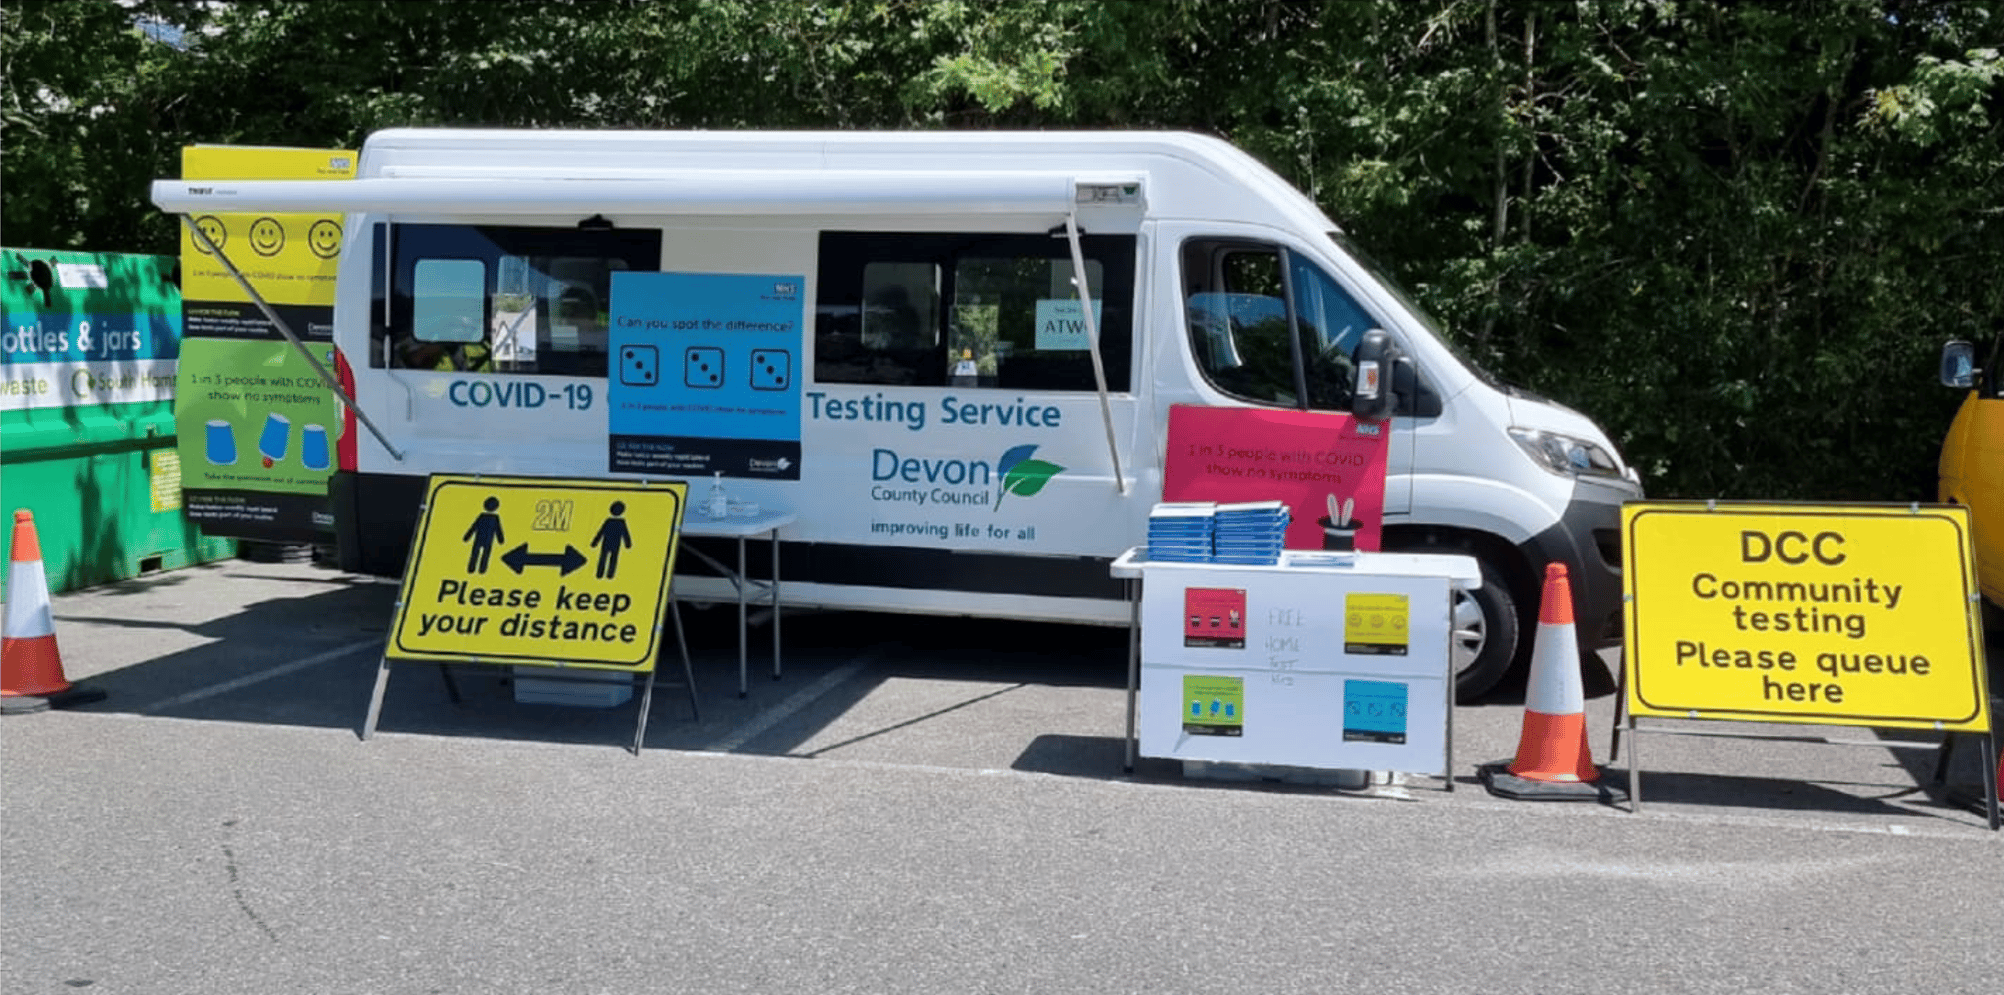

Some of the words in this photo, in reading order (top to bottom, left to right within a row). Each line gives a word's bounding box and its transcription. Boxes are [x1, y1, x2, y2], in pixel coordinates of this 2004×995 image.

[77, 320, 95, 352] &
[101, 320, 141, 358] jars
[616, 315, 642, 328] Can
[646, 320, 667, 331] you
[672, 319, 699, 331] spot
[701, 318, 723, 330] the
[725, 320, 794, 332] difference?
[98, 369, 136, 391] South
[224, 375, 267, 387] people
[270, 376, 294, 388] with
[449, 380, 593, 411] COVID-19
[207, 390, 240, 400] show
[244, 391, 260, 401] no
[262, 393, 321, 405] symptoms
[806, 392, 926, 431] Testing
[941, 396, 1061, 428] Service
[872, 448, 990, 485] Devon
[1228, 447, 1276, 461] people
[1315, 451, 1364, 467] COVID
[1206, 462, 1243, 476] show
[1247, 466, 1267, 478] no
[1270, 468, 1342, 485] symptoms
[871, 486, 928, 506] County
[931, 487, 989, 506] Council
[532, 499, 574, 532] 2M
[871, 519, 948, 540] improving
[955, 522, 980, 537] life
[988, 524, 1010, 539] for
[1017, 526, 1036, 540] all
[1741, 530, 1847, 566] DCC
[437, 580, 541, 608] Please
[556, 585, 631, 617] keep
[1692, 573, 1903, 610] Community
[417, 613, 489, 637] your
[499, 613, 638, 644] distance
[1733, 605, 1866, 639] testing
[1676, 641, 1797, 672] Please
[1817, 653, 1931, 677] queue
[1763, 675, 1845, 704] here
